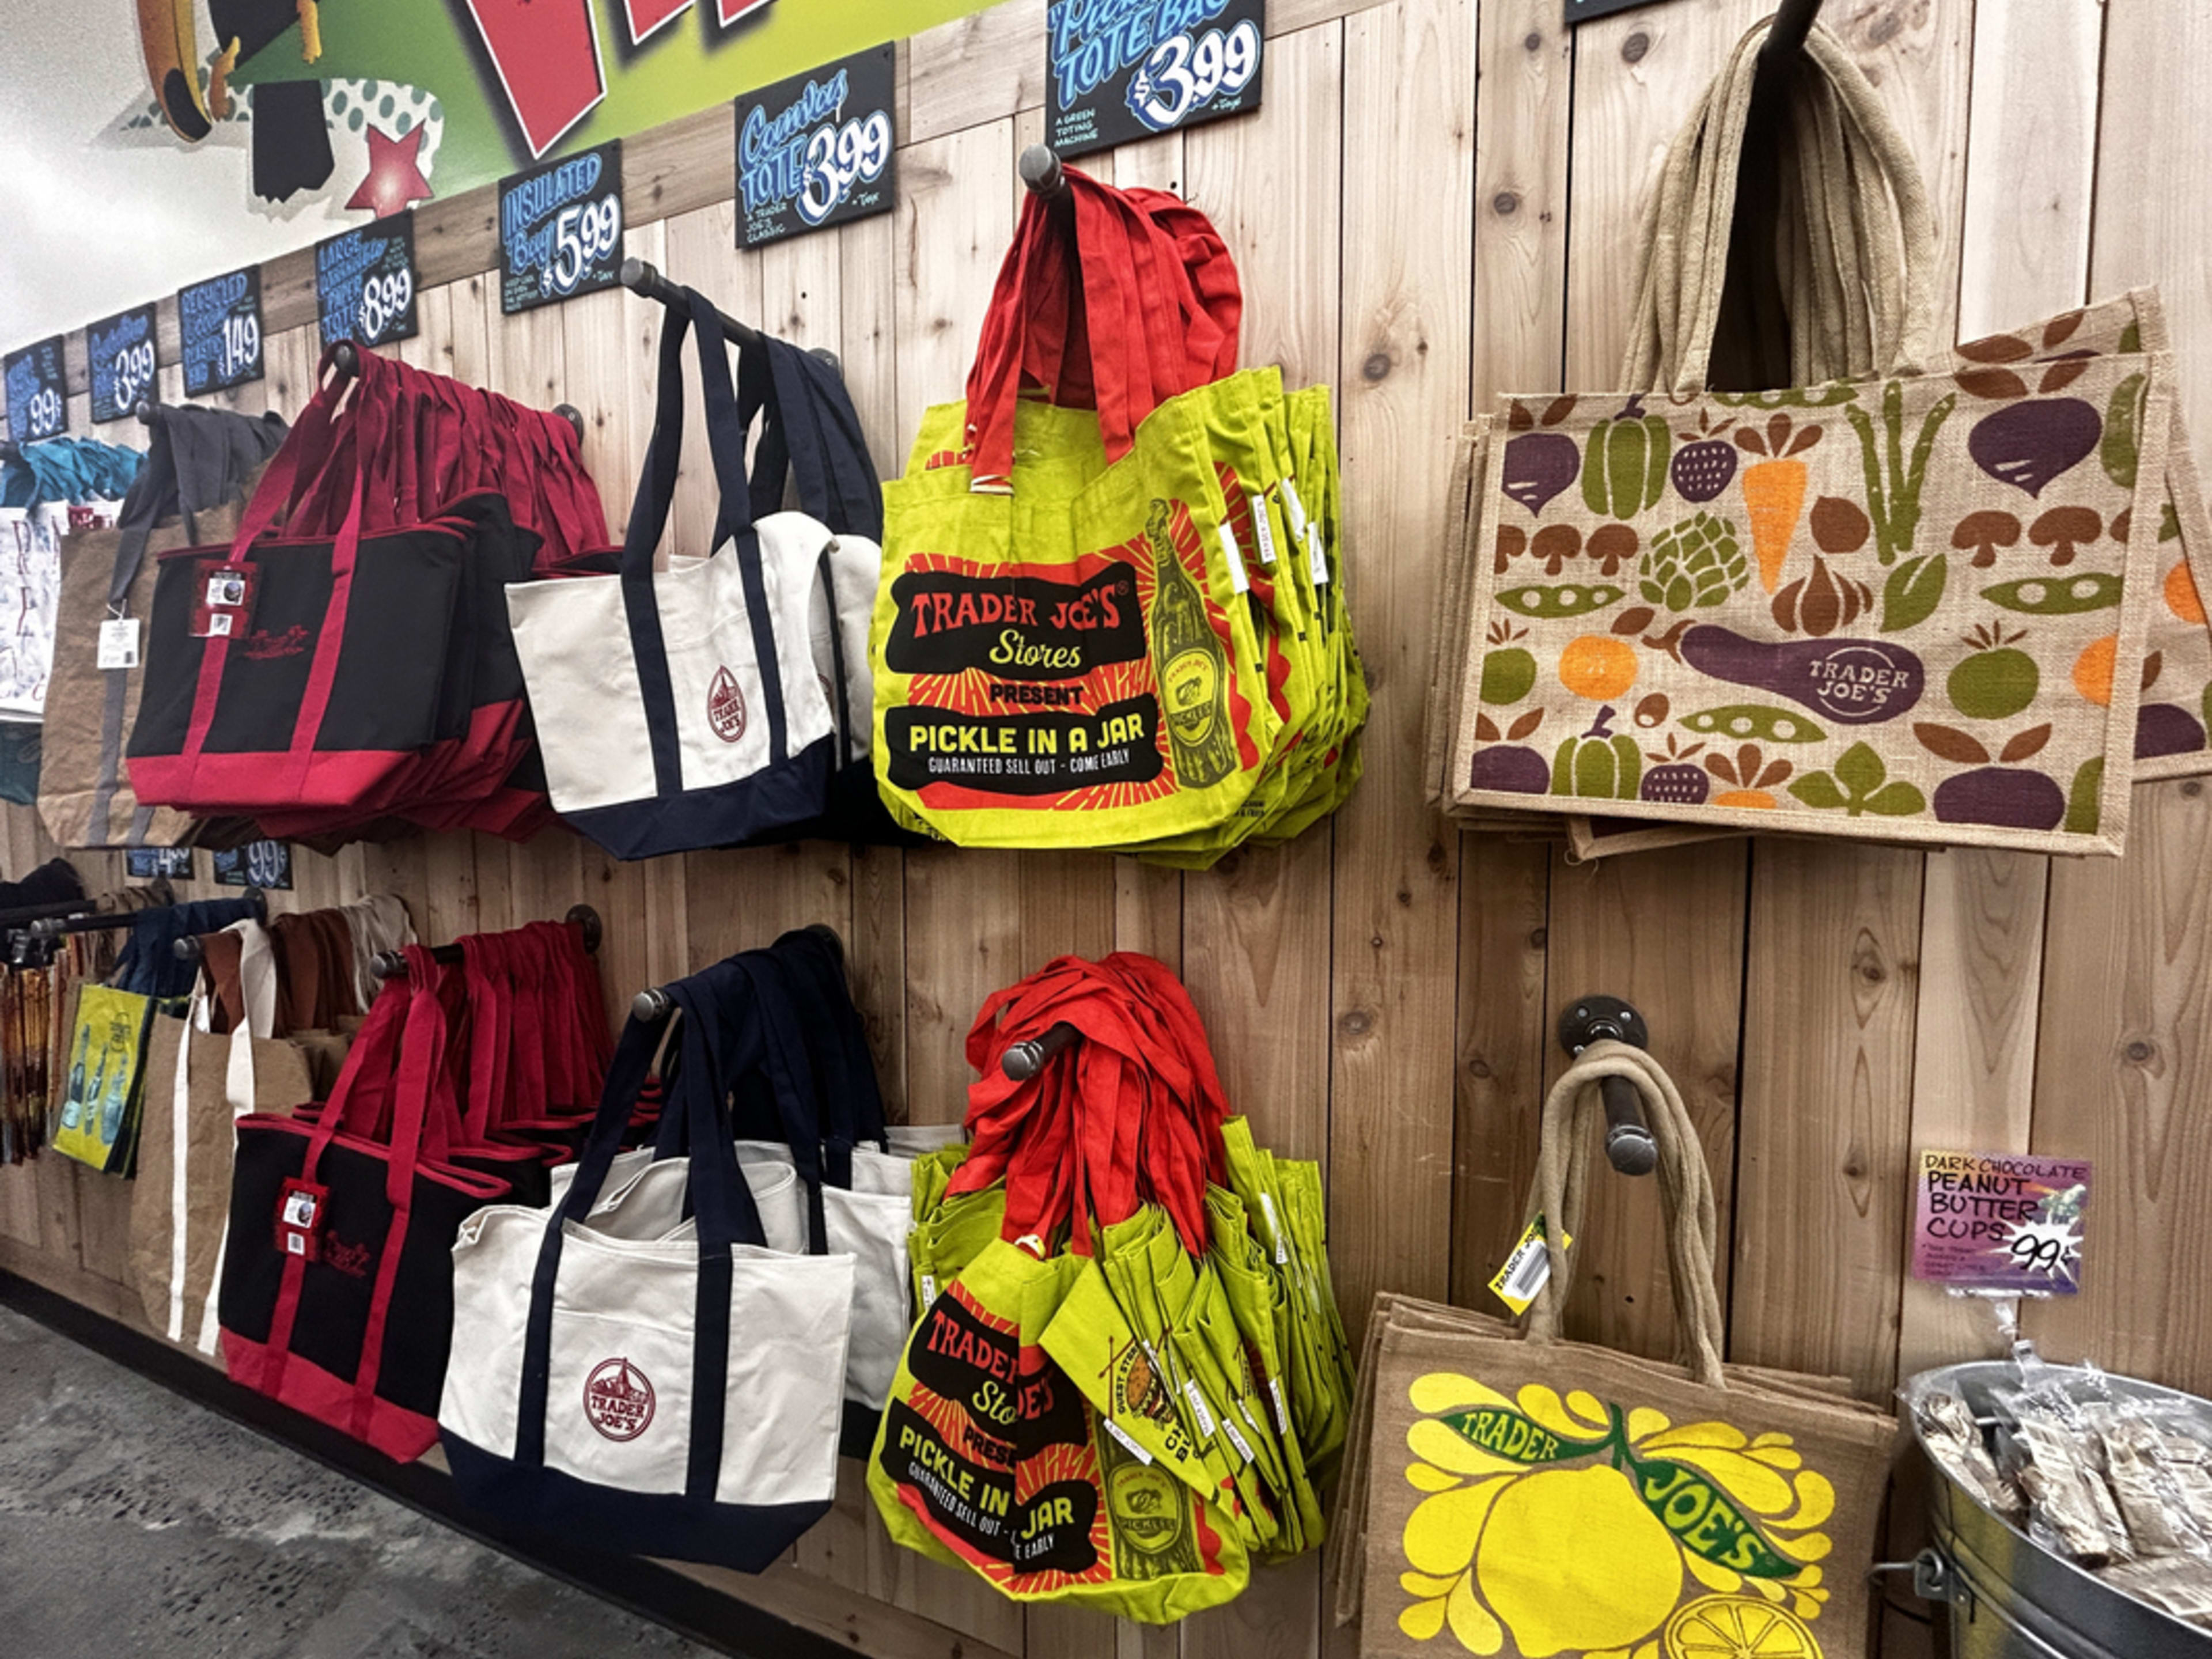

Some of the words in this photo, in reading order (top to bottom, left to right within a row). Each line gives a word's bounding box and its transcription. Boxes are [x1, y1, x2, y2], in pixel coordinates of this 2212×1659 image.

[1059, 6, 1153, 103] TOTE
[1152, 0, 1228, 43] BA
[740, 69, 849, 167] Canvas
[1064, 108, 1096, 124] GREEN
[739, 134, 808, 212] TOTE
[503, 154, 601, 245] INSULATED
[509, 222, 555, 274] Bag
[911, 593, 1038, 638] TRADER
[989, 628, 1082, 669] Stores
[1809, 660, 1910, 689] TRADER
[1816, 680, 1892, 704] JOE'S
[989, 684, 1084, 707] PRESENT
[910, 725, 1017, 754] PICKLE
[1028, 728, 1058, 755] IN
[1069, 727, 1089, 752] A
[1097, 713, 1145, 749] JAR
[927, 756, 1003, 775] GUARANTEED
[1006, 757, 1031, 775] SELL
[1034, 758, 1056, 775] OUT
[1069, 754, 1100, 774] COME
[1100, 747, 1131, 770] EARLY
[1925, 1154, 1975, 1171] DARK
[1979, 1158, 2087, 1181] CHOCOLATE
[1927, 1171, 2031, 1195] PEANUT
[1931, 1192, 2040, 1221] BUTTER
[1927, 1217, 2006, 1242] CUPS
[1494, 1248, 1526, 1290] TRADER
[591, 1395, 645, 1418] TRADER
[598, 1412, 638, 1431] JOE'S
[1461, 1411, 1559, 1460] TRADER
[899, 1424, 974, 1502] PICKLE
[979, 1483, 1011, 1517] IN
[1020, 1497, 1075, 1540] JAR
[908, 1461, 957, 1513] GUARANTEED
[955, 1501, 978, 1528] SELL
[979, 1516, 1001, 1537] OUT
[1024, 1533, 1055, 1560] EARLY
[1645, 1468, 1768, 1570] JOE'S
